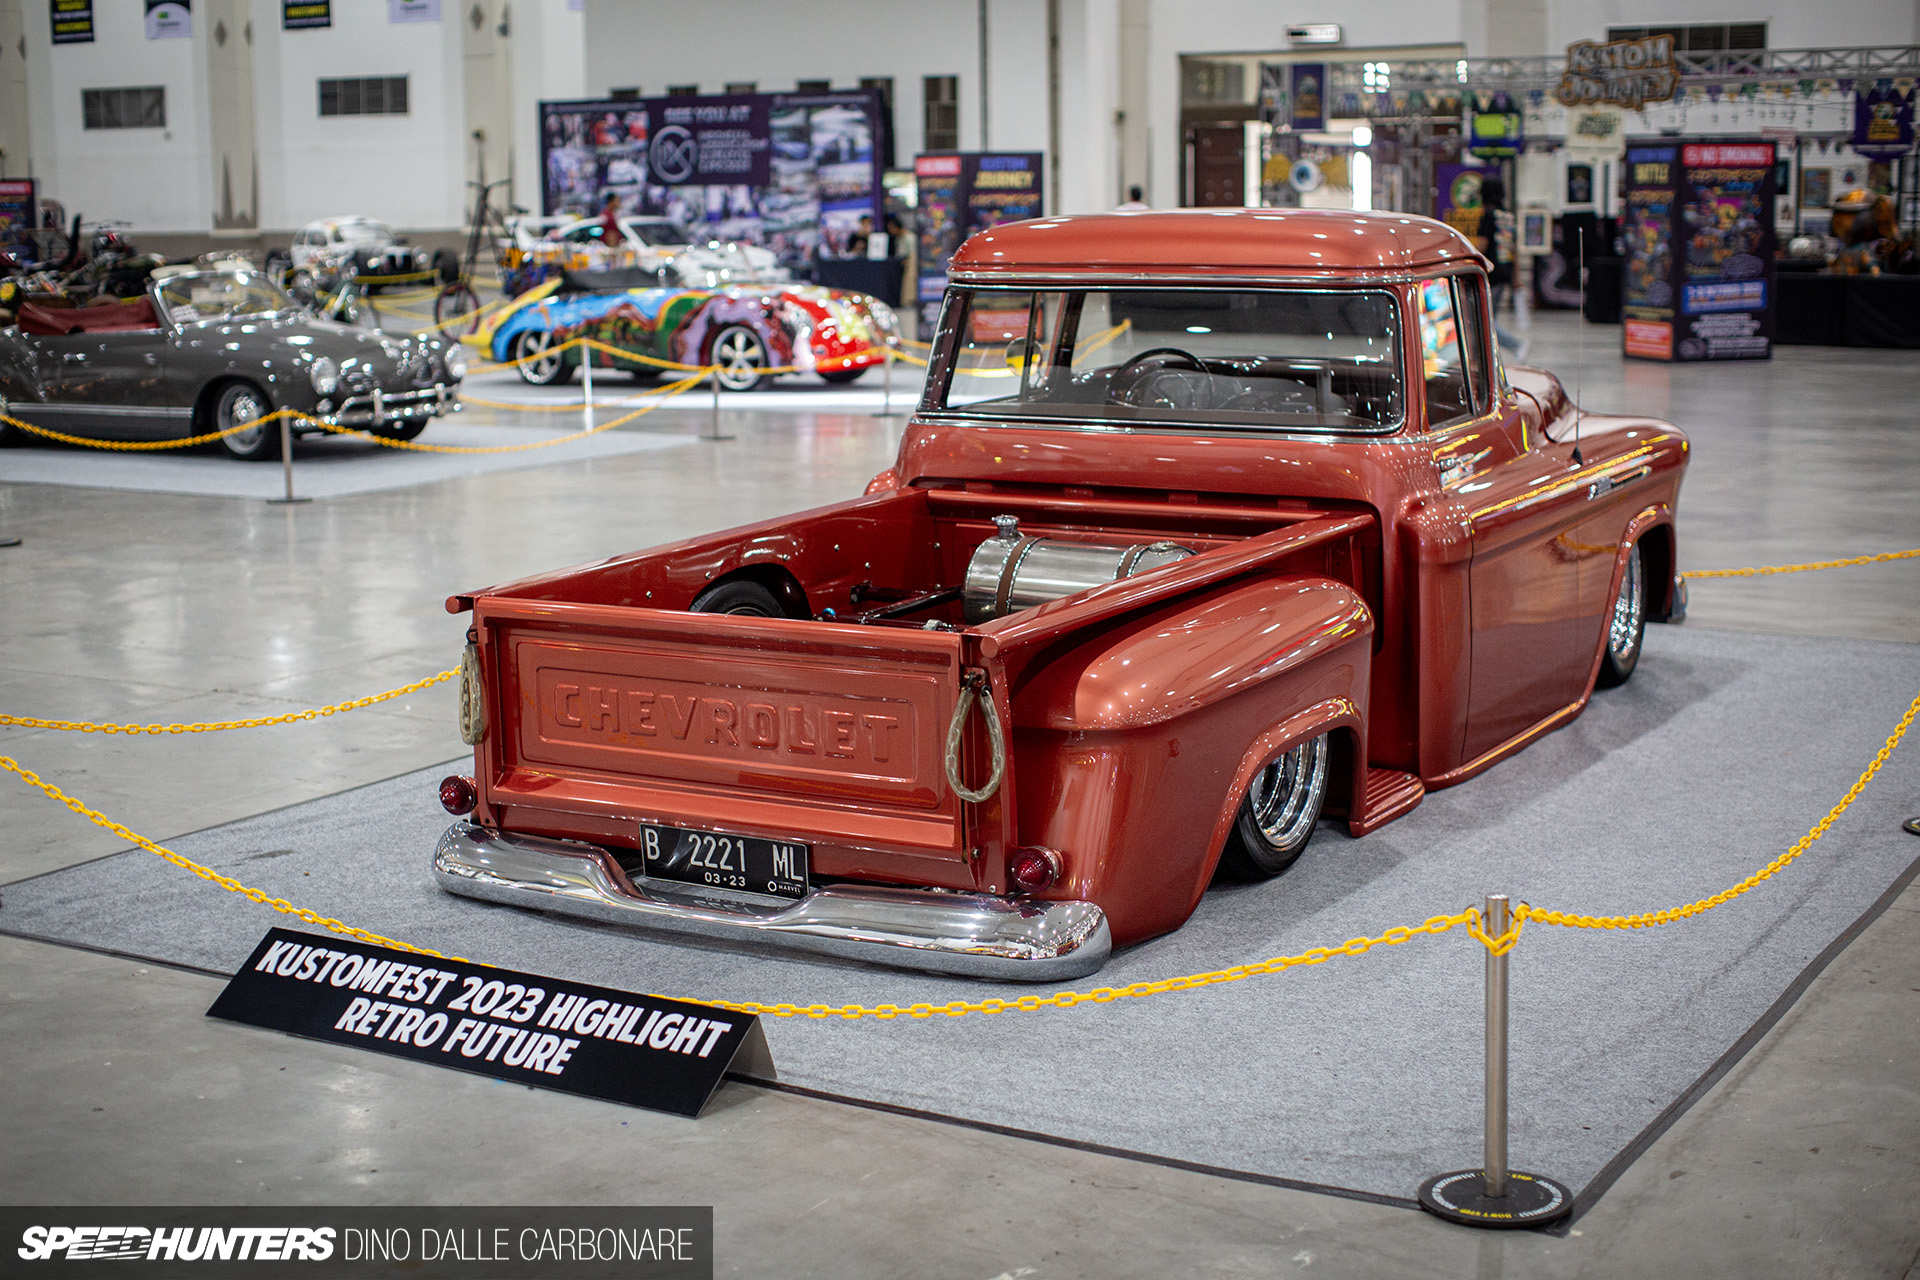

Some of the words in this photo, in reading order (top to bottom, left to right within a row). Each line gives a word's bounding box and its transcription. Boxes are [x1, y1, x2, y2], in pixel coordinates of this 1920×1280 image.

[554, 683, 898, 763] CHEVROLET
[645, 828, 661, 861] B
[688, 834, 746, 873] 2221
[772, 844, 804, 882] ML
[778, 884, 801, 893] MARVEL
[255, 940, 457, 1002] KUSTOMFEST
[448, 975, 542, 1024] 2023
[538, 992, 732, 1058] HIGHLIGHT
[334, 997, 445, 1048] RETRO
[441, 1022, 580, 1075] FUTURE
